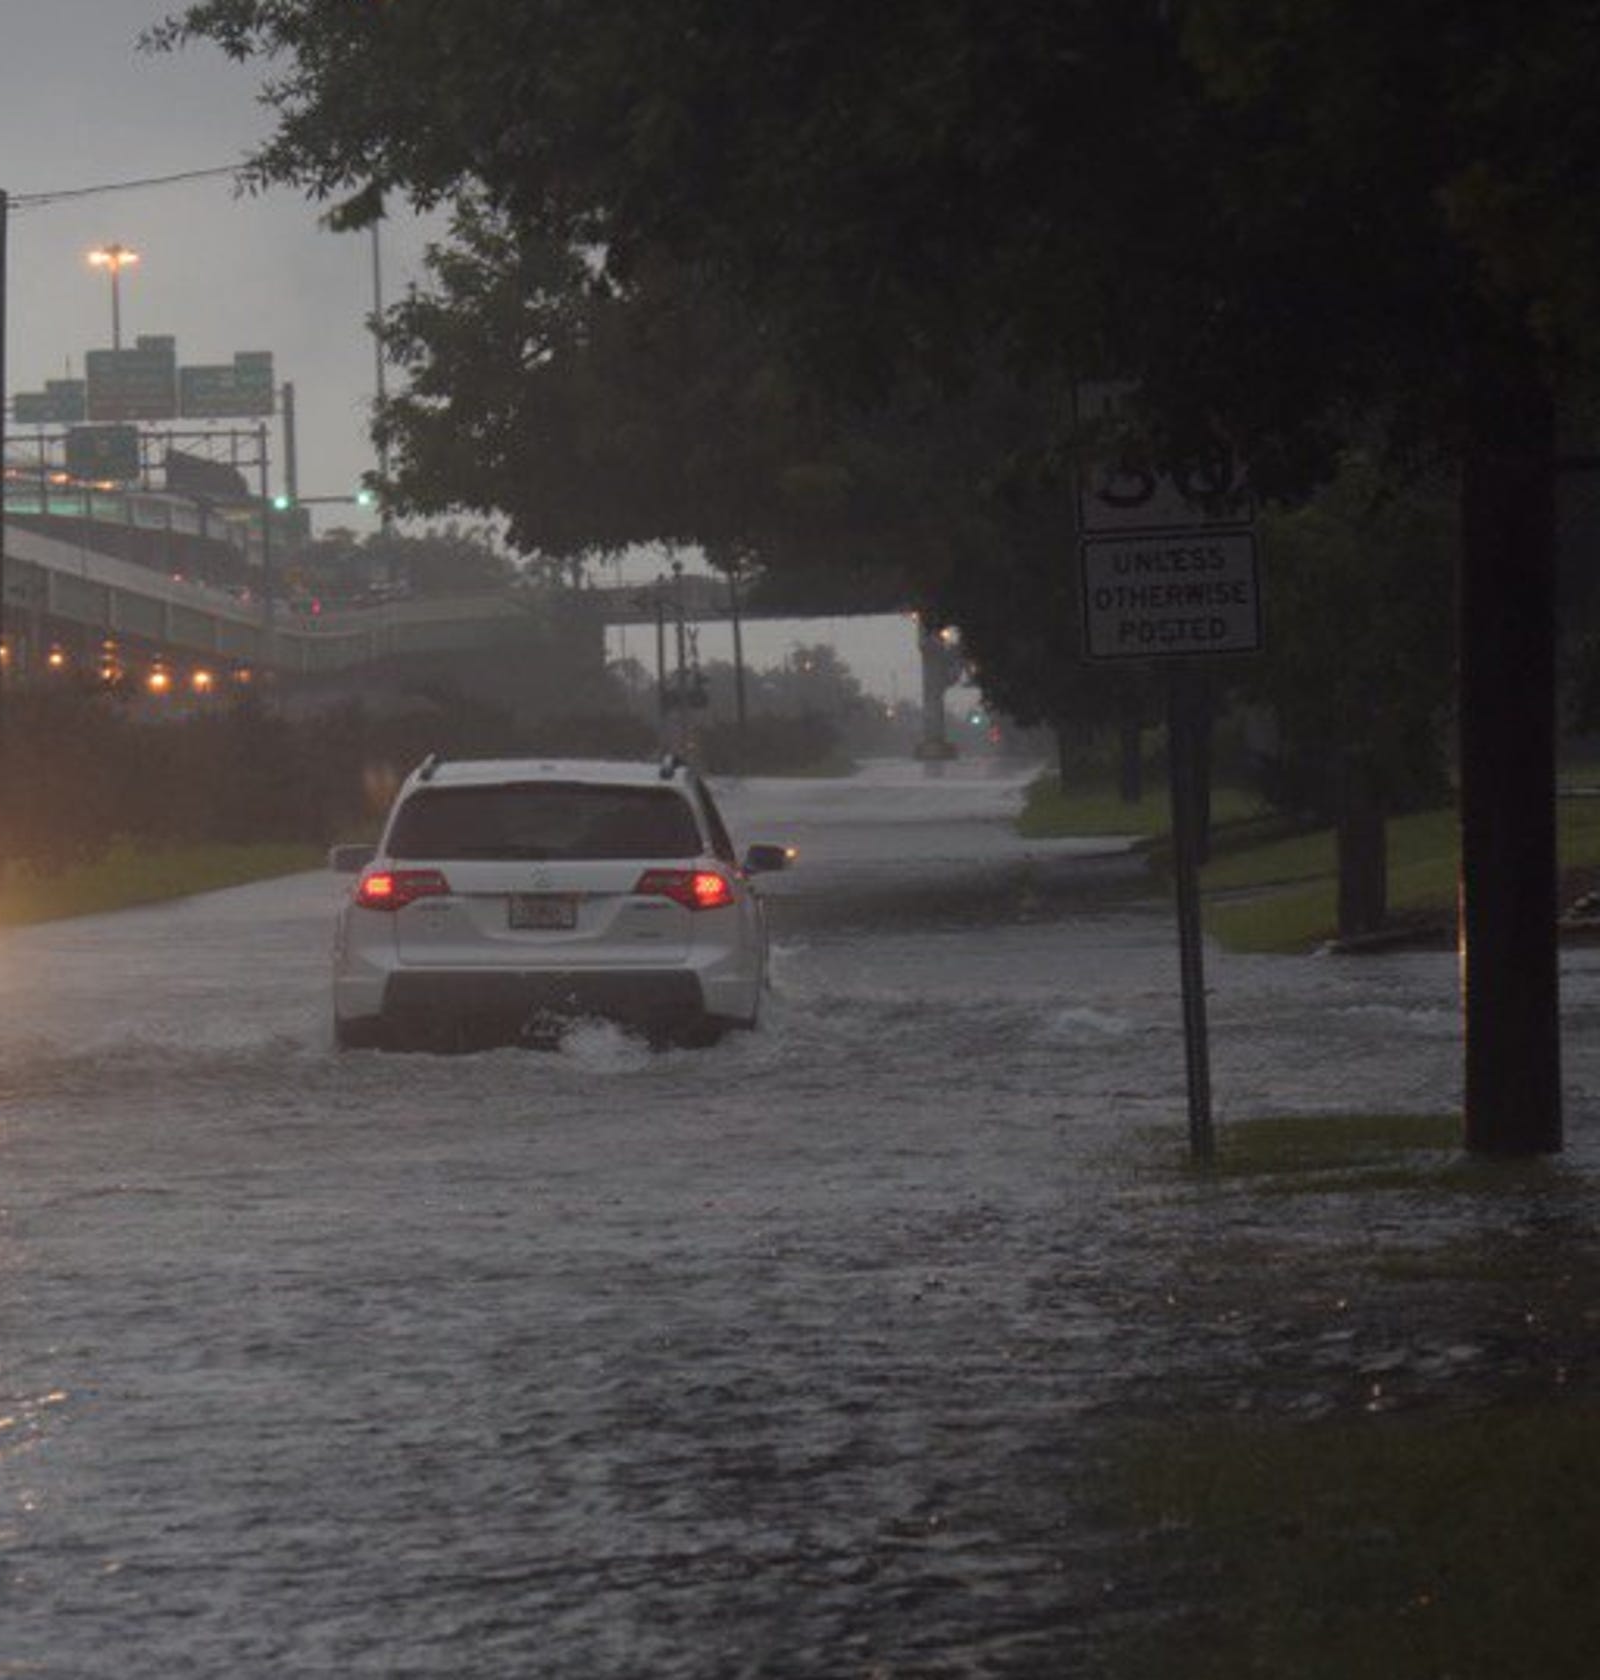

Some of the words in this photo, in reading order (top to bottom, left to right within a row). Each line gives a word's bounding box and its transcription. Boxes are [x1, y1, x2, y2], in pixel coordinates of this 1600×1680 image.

[1114, 549, 1226, 574] UNLESS
[1096, 581, 1248, 611] OTHERWISE
[1119, 617, 1226, 645] POSTED
